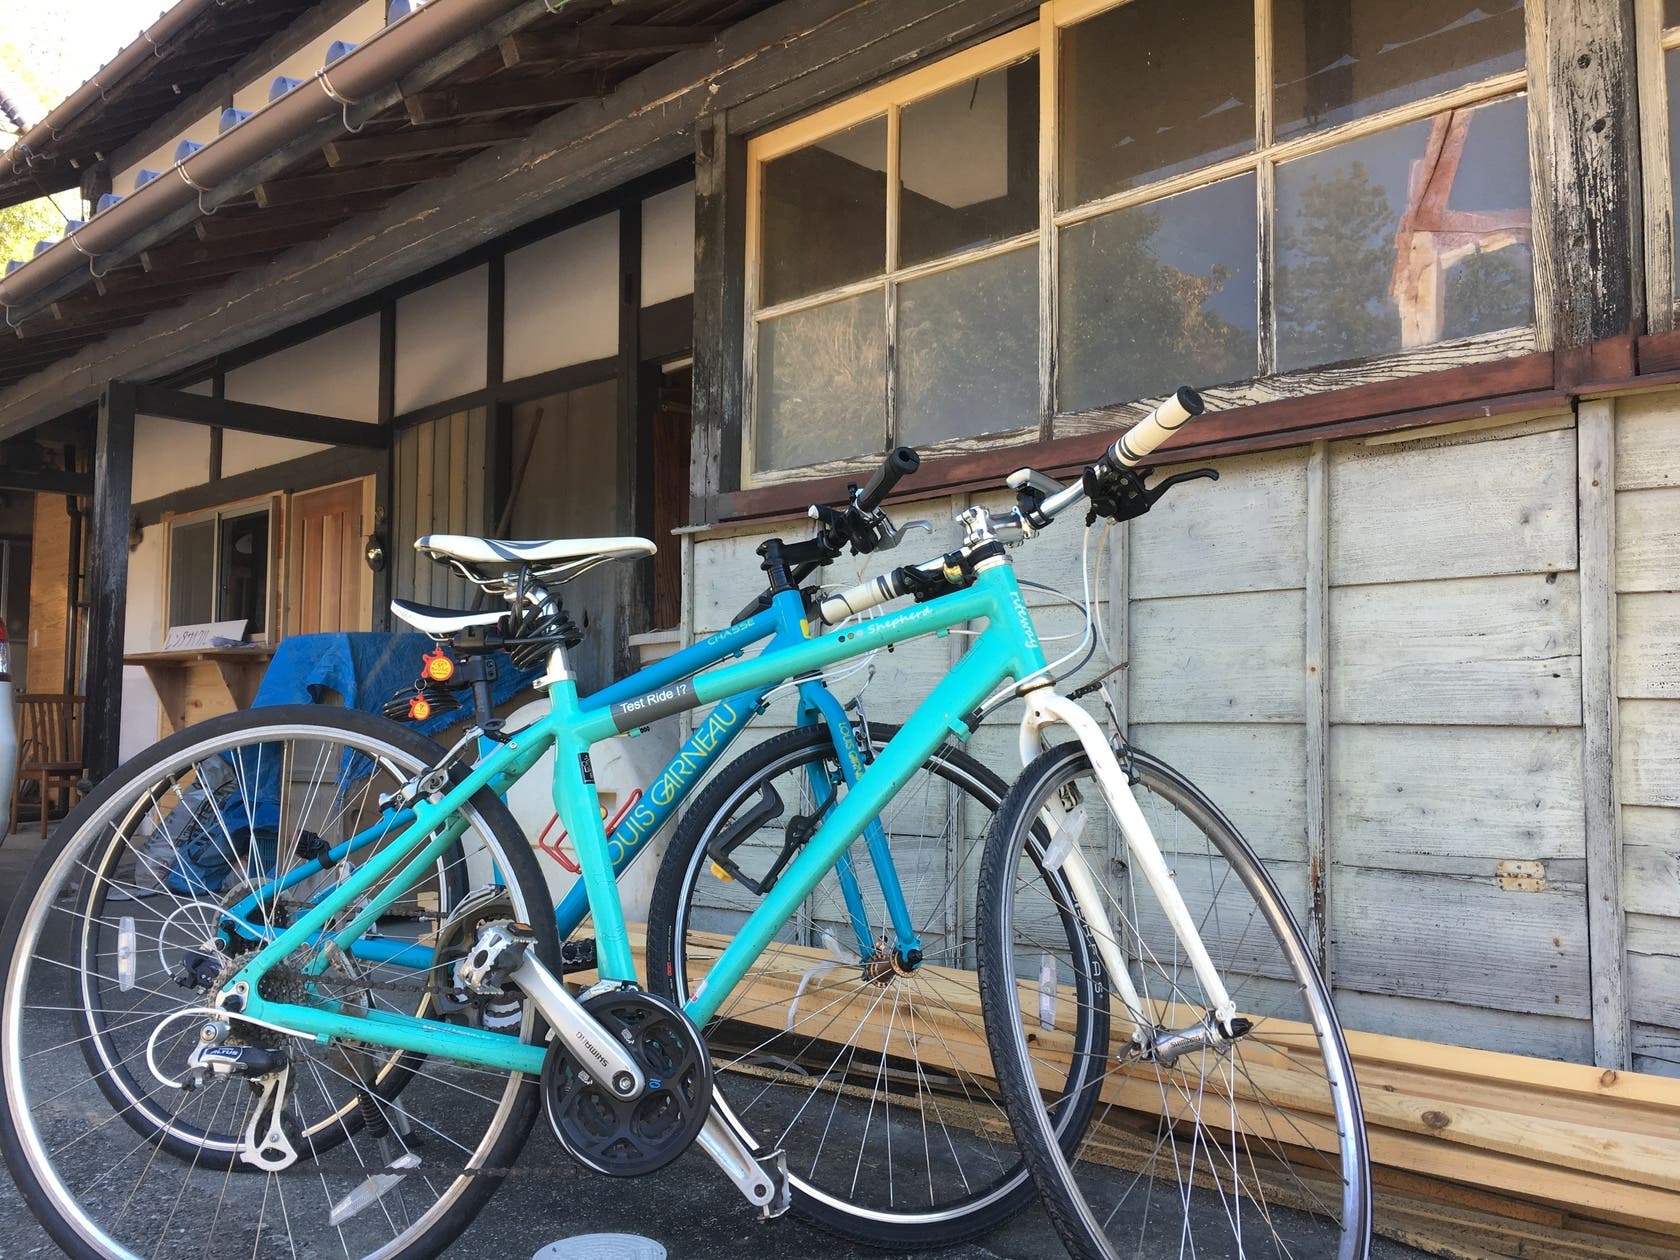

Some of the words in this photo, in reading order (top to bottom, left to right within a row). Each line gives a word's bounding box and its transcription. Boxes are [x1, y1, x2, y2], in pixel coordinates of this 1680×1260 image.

[707, 617, 756, 646] CHASSE
[867, 605, 933, 635] Shepherd
[620, 699, 645, 714] Test
[646, 690, 674, 706] Ride
[606, 803, 655, 866] OUIS
[651, 703, 737, 806] GARNEAU
